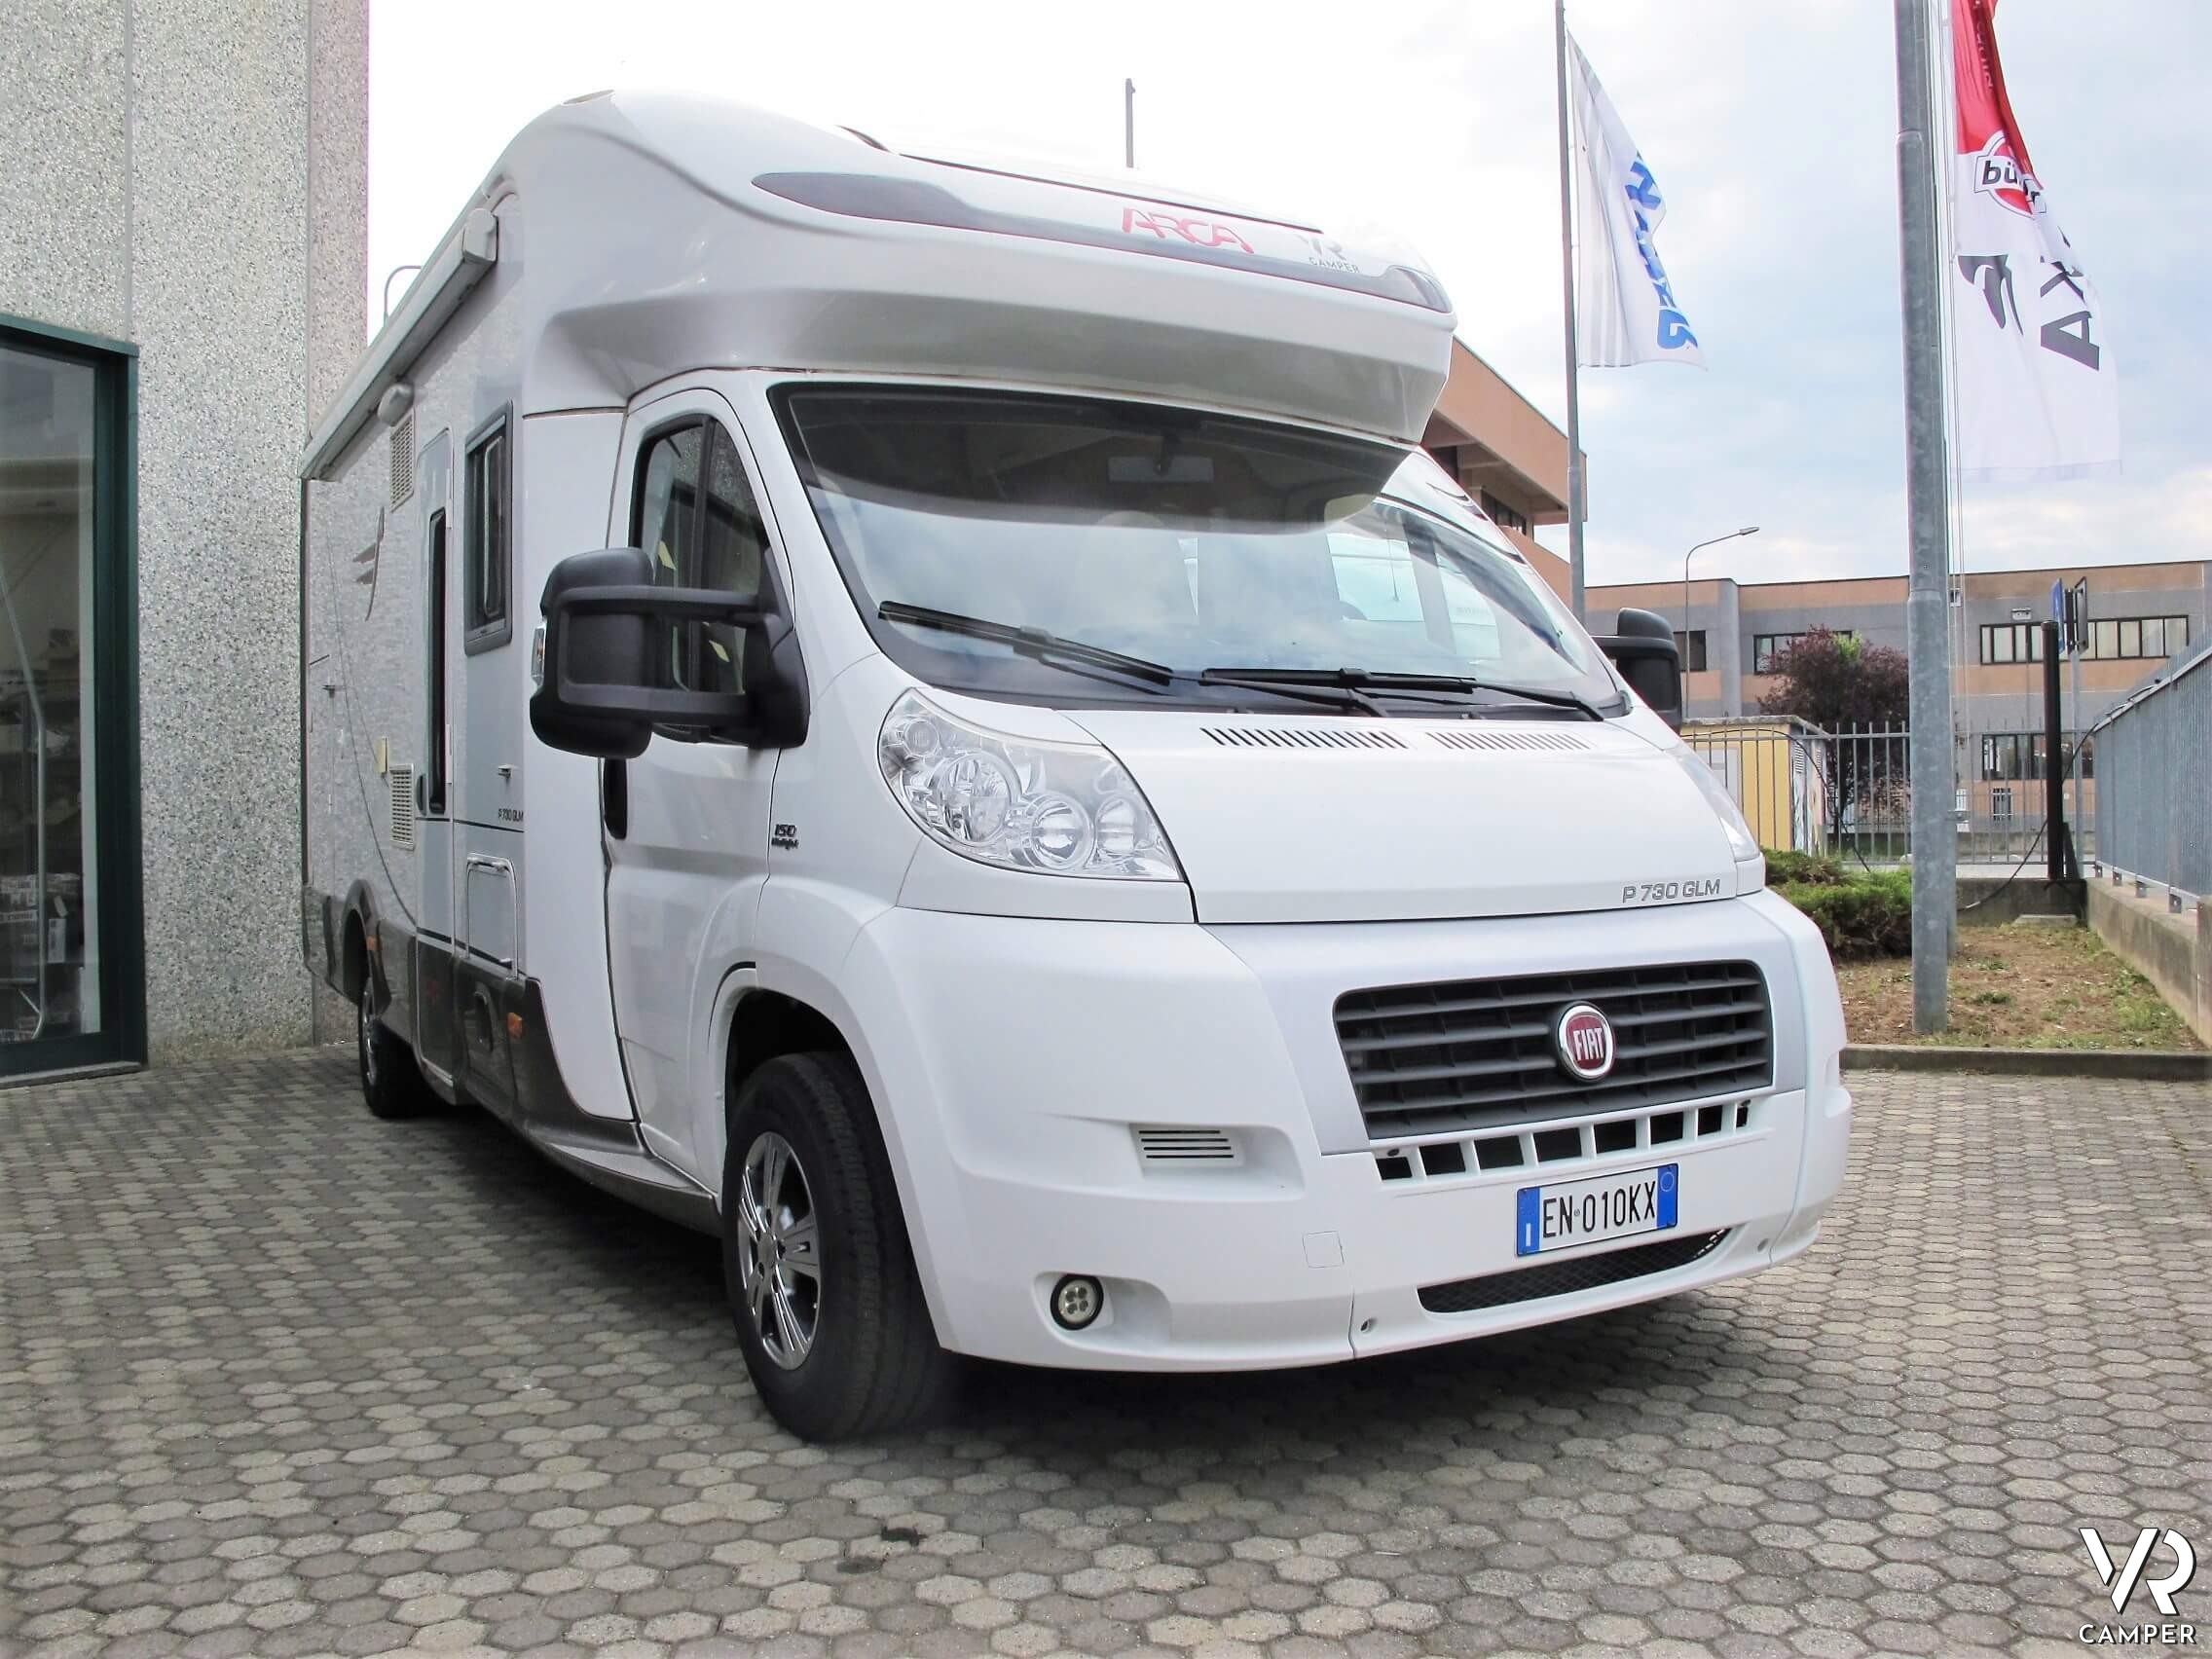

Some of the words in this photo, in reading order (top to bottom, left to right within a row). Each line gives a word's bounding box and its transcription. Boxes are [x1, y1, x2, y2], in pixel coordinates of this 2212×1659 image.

[1123, 207, 1254, 253] ARCA
[1309, 256, 1361, 274] CAMPER
[1622, 886, 1636, 903] P
[1641, 883, 1678, 902] 730
[1682, 878, 1720, 897] GLM
[1573, 1027, 1604, 1061] FIAT
